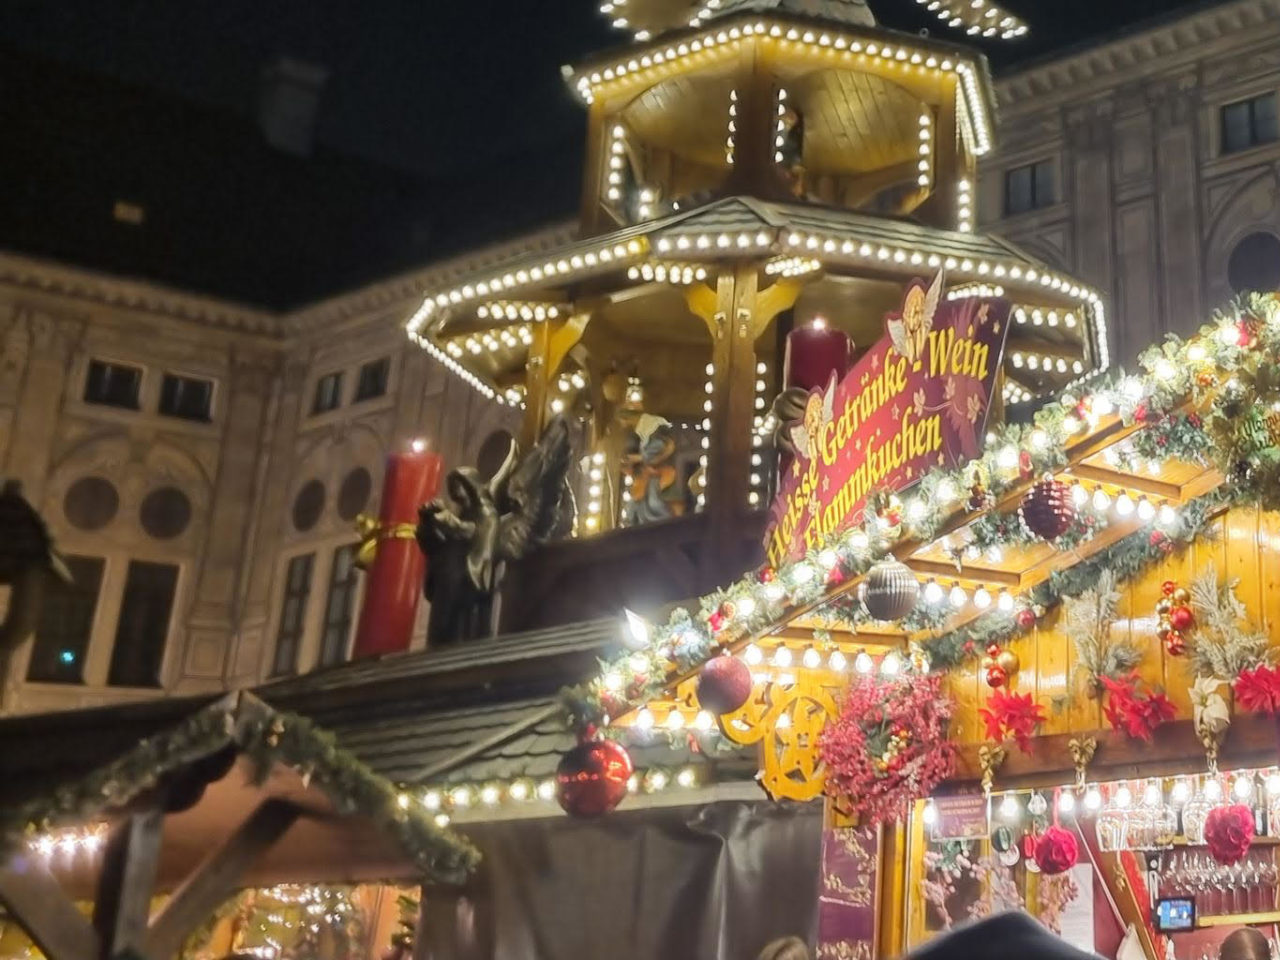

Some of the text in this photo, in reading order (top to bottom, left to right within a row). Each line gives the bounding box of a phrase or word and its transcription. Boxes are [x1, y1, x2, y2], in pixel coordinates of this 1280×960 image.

[767, 457, 820, 569] Heisse
[822, 345, 908, 466] Getränke
[928, 324, 990, 381] Wein
[804, 405, 943, 549] Flammkuchen
